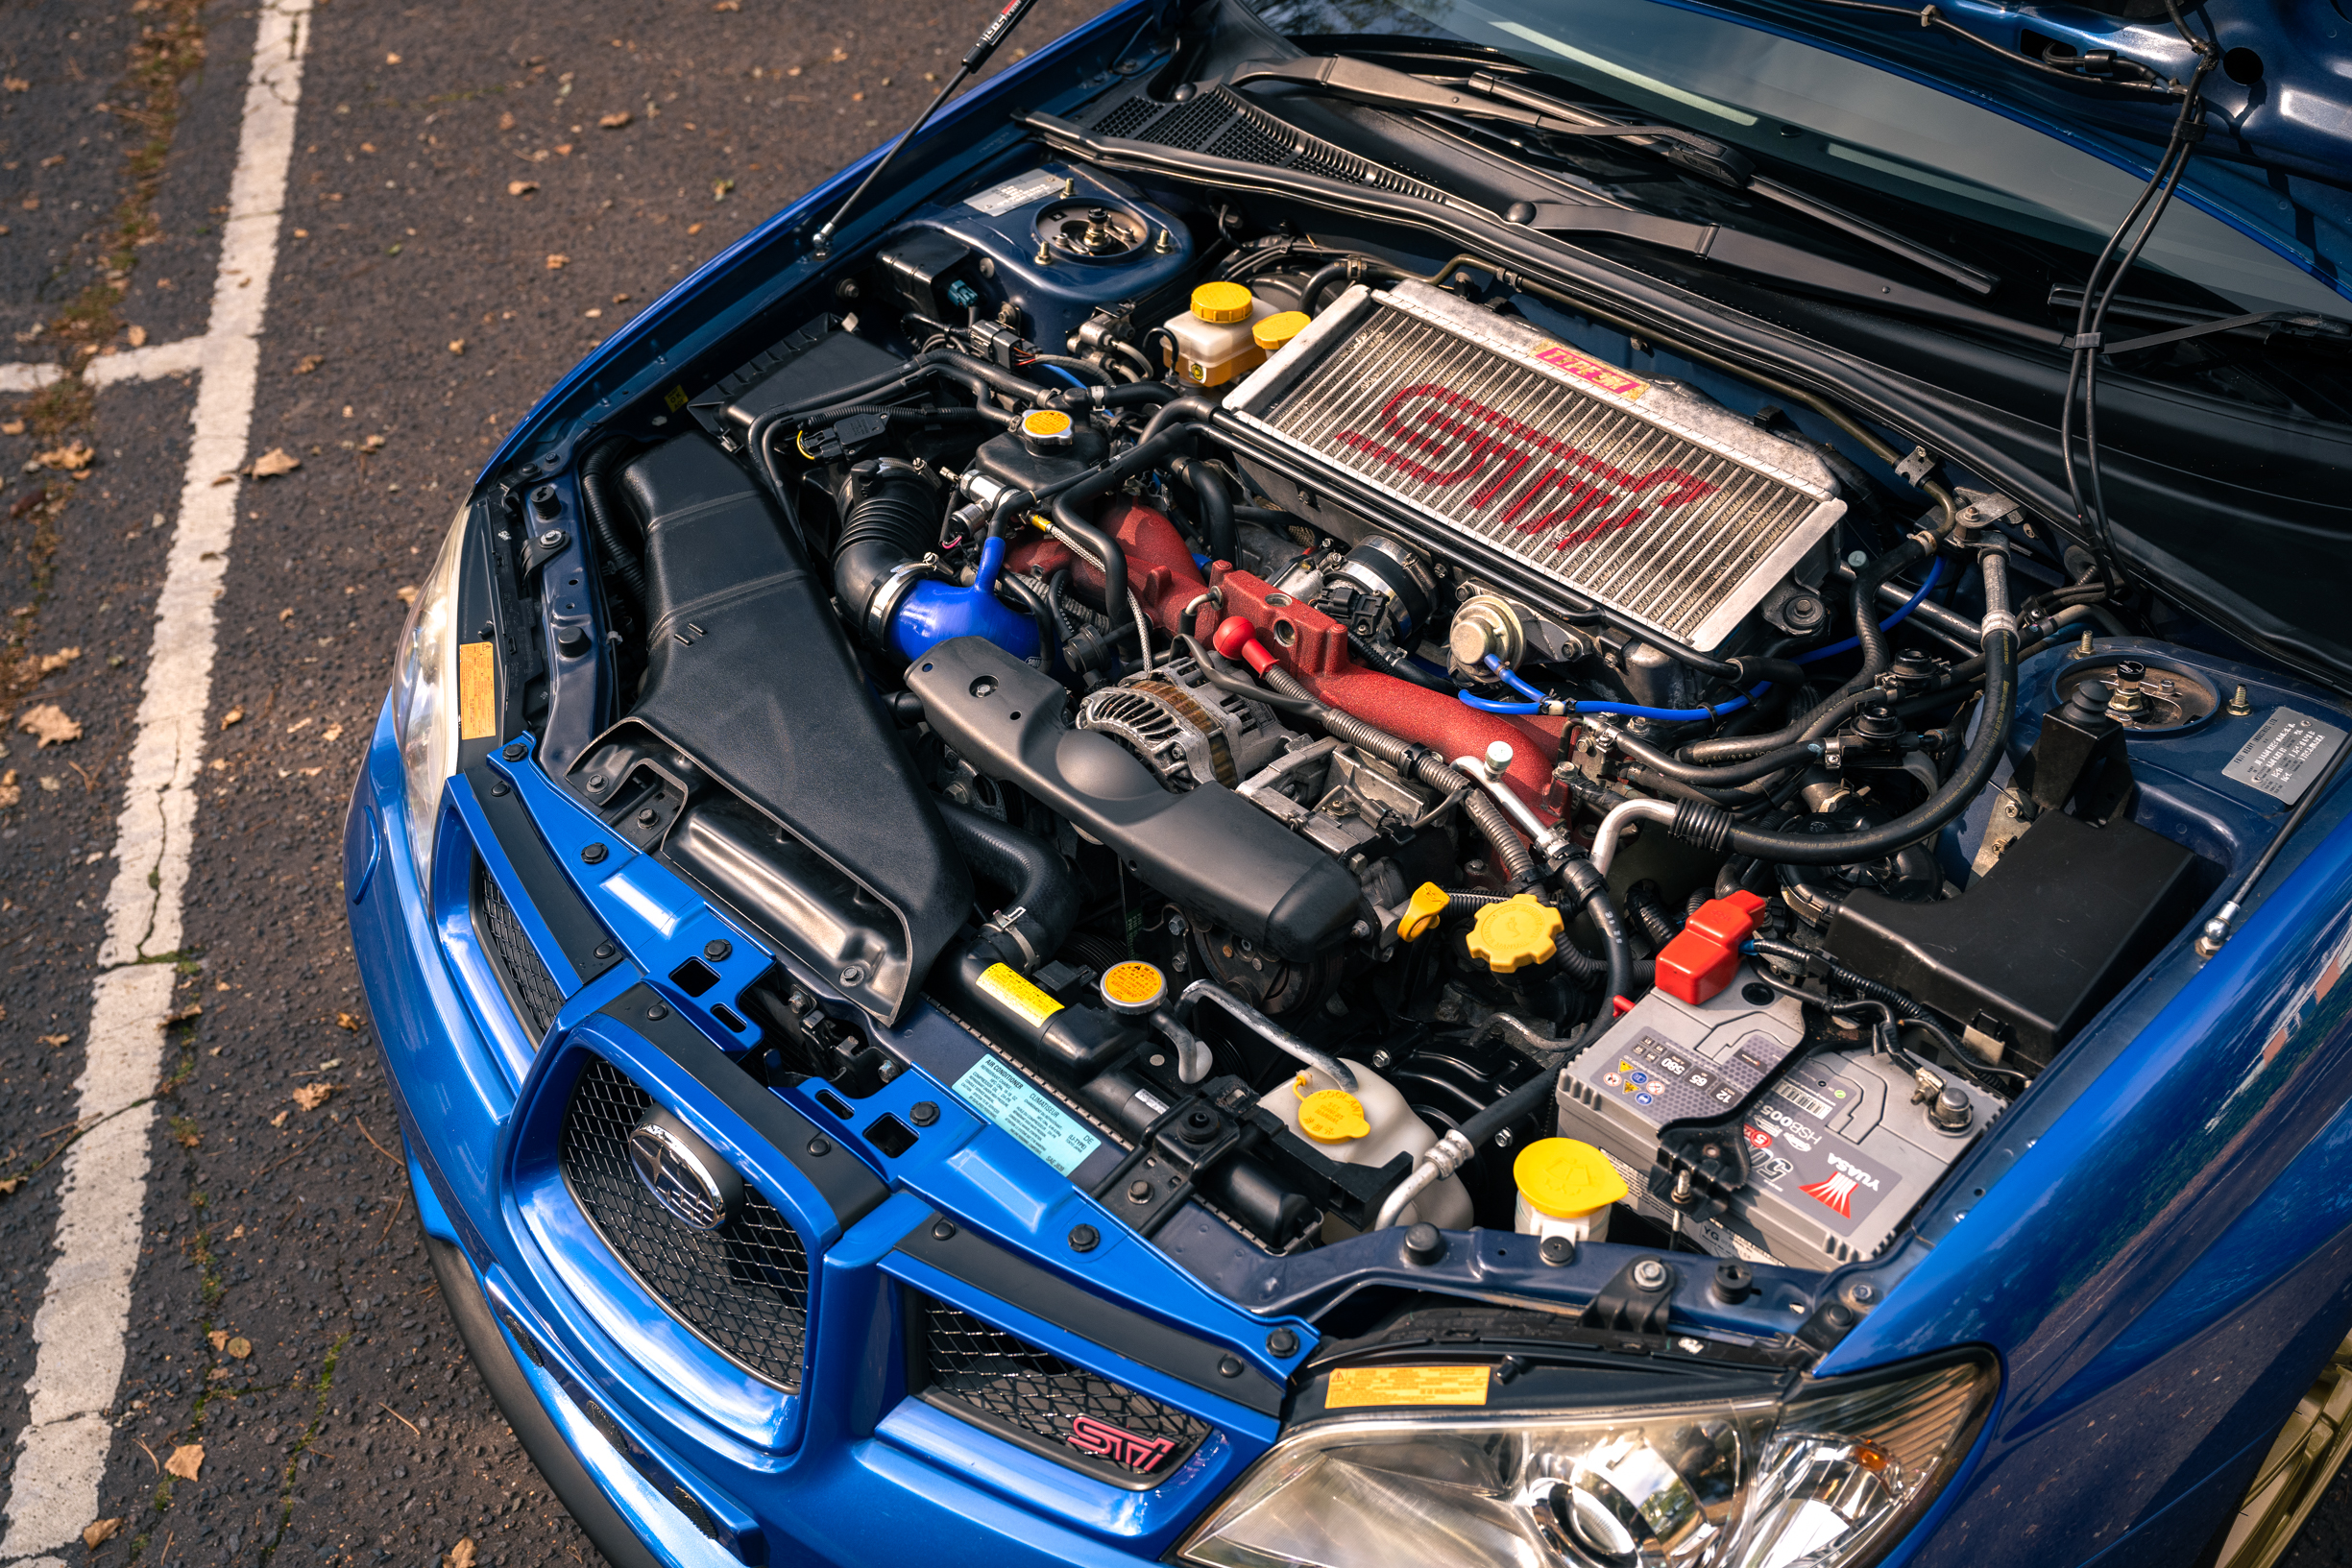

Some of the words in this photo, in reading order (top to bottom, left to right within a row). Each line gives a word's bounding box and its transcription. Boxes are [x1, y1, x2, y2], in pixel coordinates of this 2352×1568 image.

[980, 1064, 1001, 1080] REFRIGERANT
[984, 1058, 996, 1068] AIR
[991, 1064, 1024, 1089] CONDITIONER
[1660, 1055, 1686, 1075] 580
[971, 1071, 993, 1088] COMPRESSOR
[1687, 1073, 1709, 1088] 65
[1318, 1091, 1362, 1118] COOLANT
[1712, 1089, 1734, 1103] 12
[1029, 1093, 1060, 1118] CLIMATISEUR
[1760, 1104, 1823, 1145] HSB005
[1082, 1134, 1094, 1145] DE
[1045, 1154, 1055, 1165] SAE
[1827, 1152, 1880, 1192] YUASA
[1704, 1225, 1719, 1242] YG
